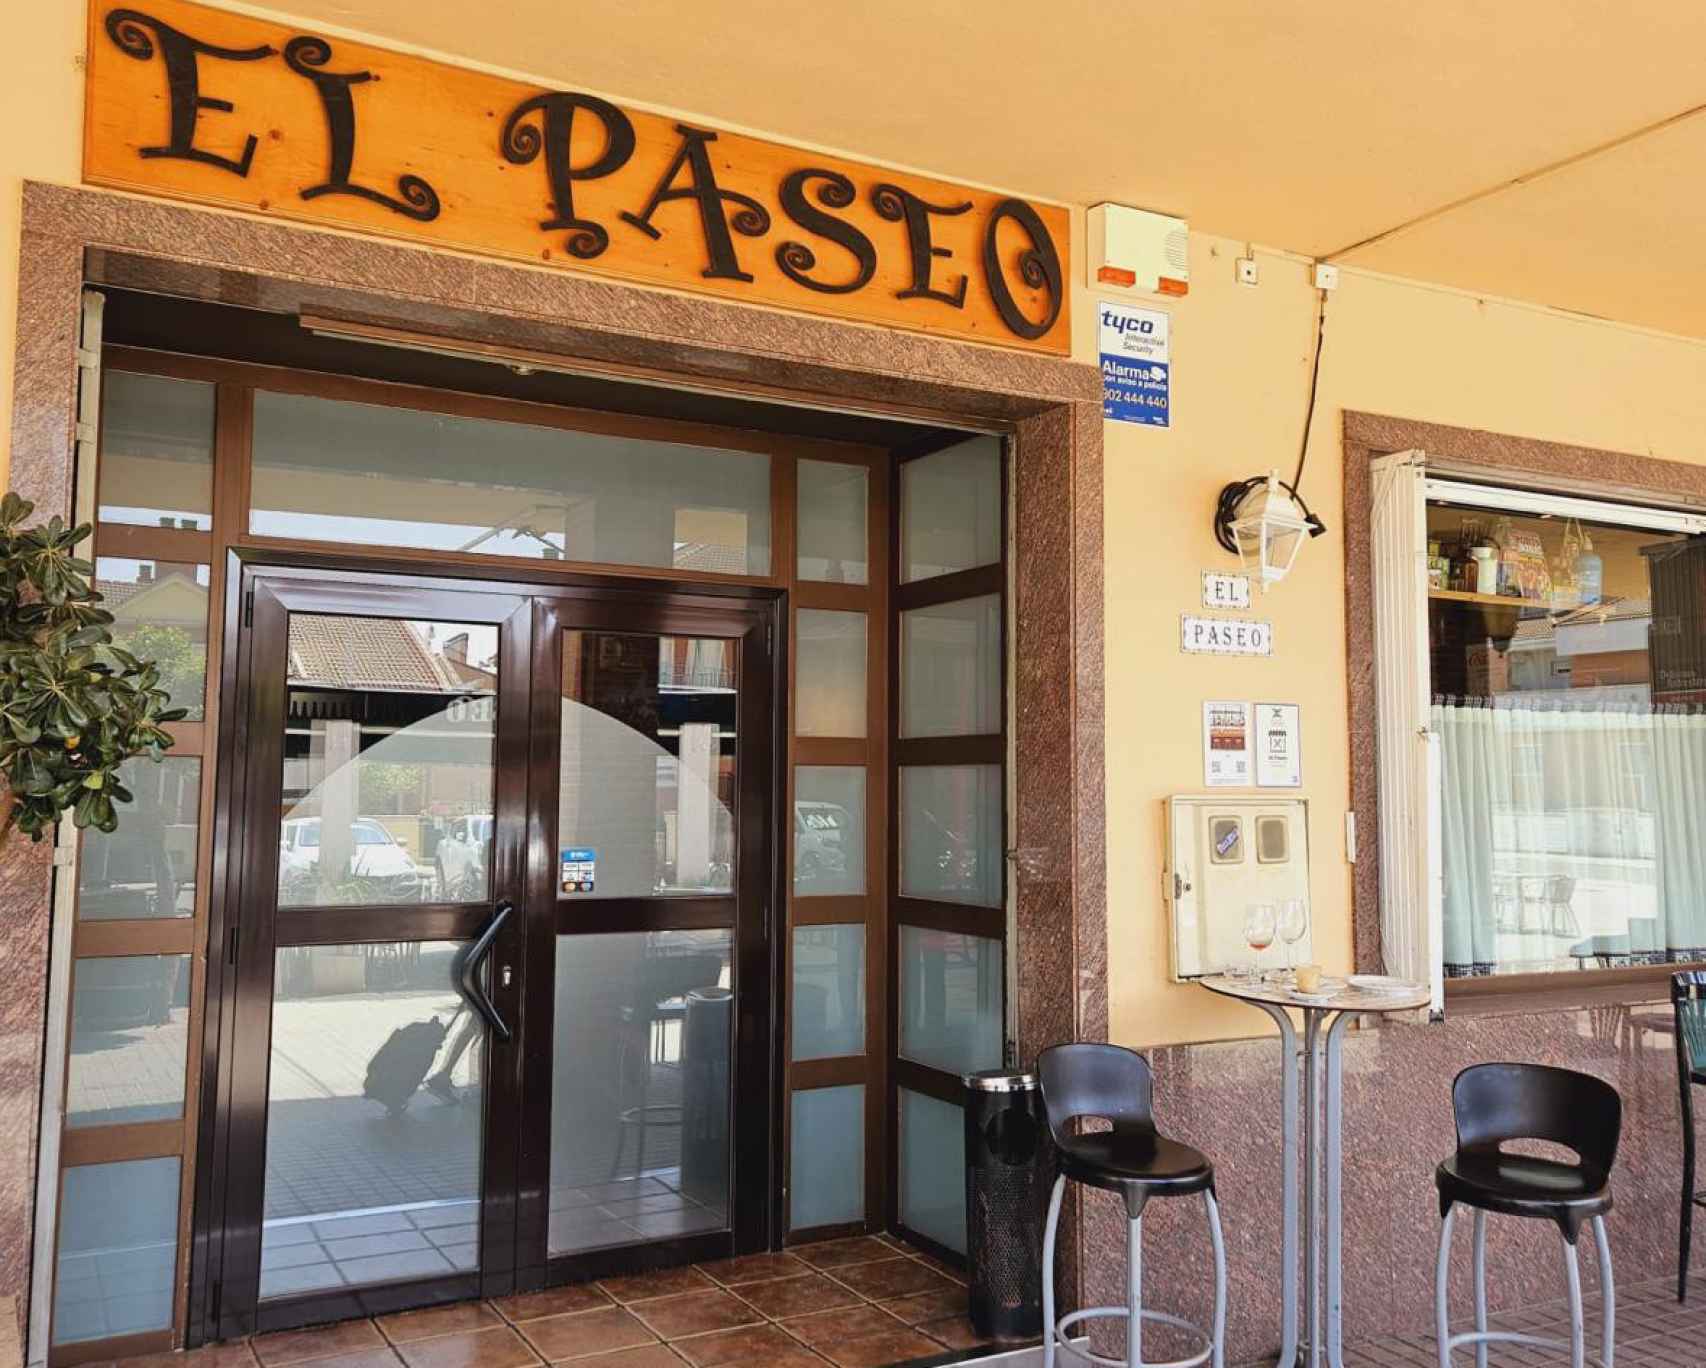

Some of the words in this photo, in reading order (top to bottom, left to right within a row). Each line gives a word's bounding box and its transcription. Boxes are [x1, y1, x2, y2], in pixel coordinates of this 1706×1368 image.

[105, 8, 441, 223] EL
[502, 91, 1063, 341] PASEO
[1101, 310, 1153, 334] tyco
[1122, 341, 1153, 355] Security
[1103, 359, 1149, 380] Alarma
[1124, 391, 1144, 405] 444
[1146, 395, 1167, 409] 440
[1215, 581, 1239, 601] EL
[1194, 624, 1261, 647] PASEO
